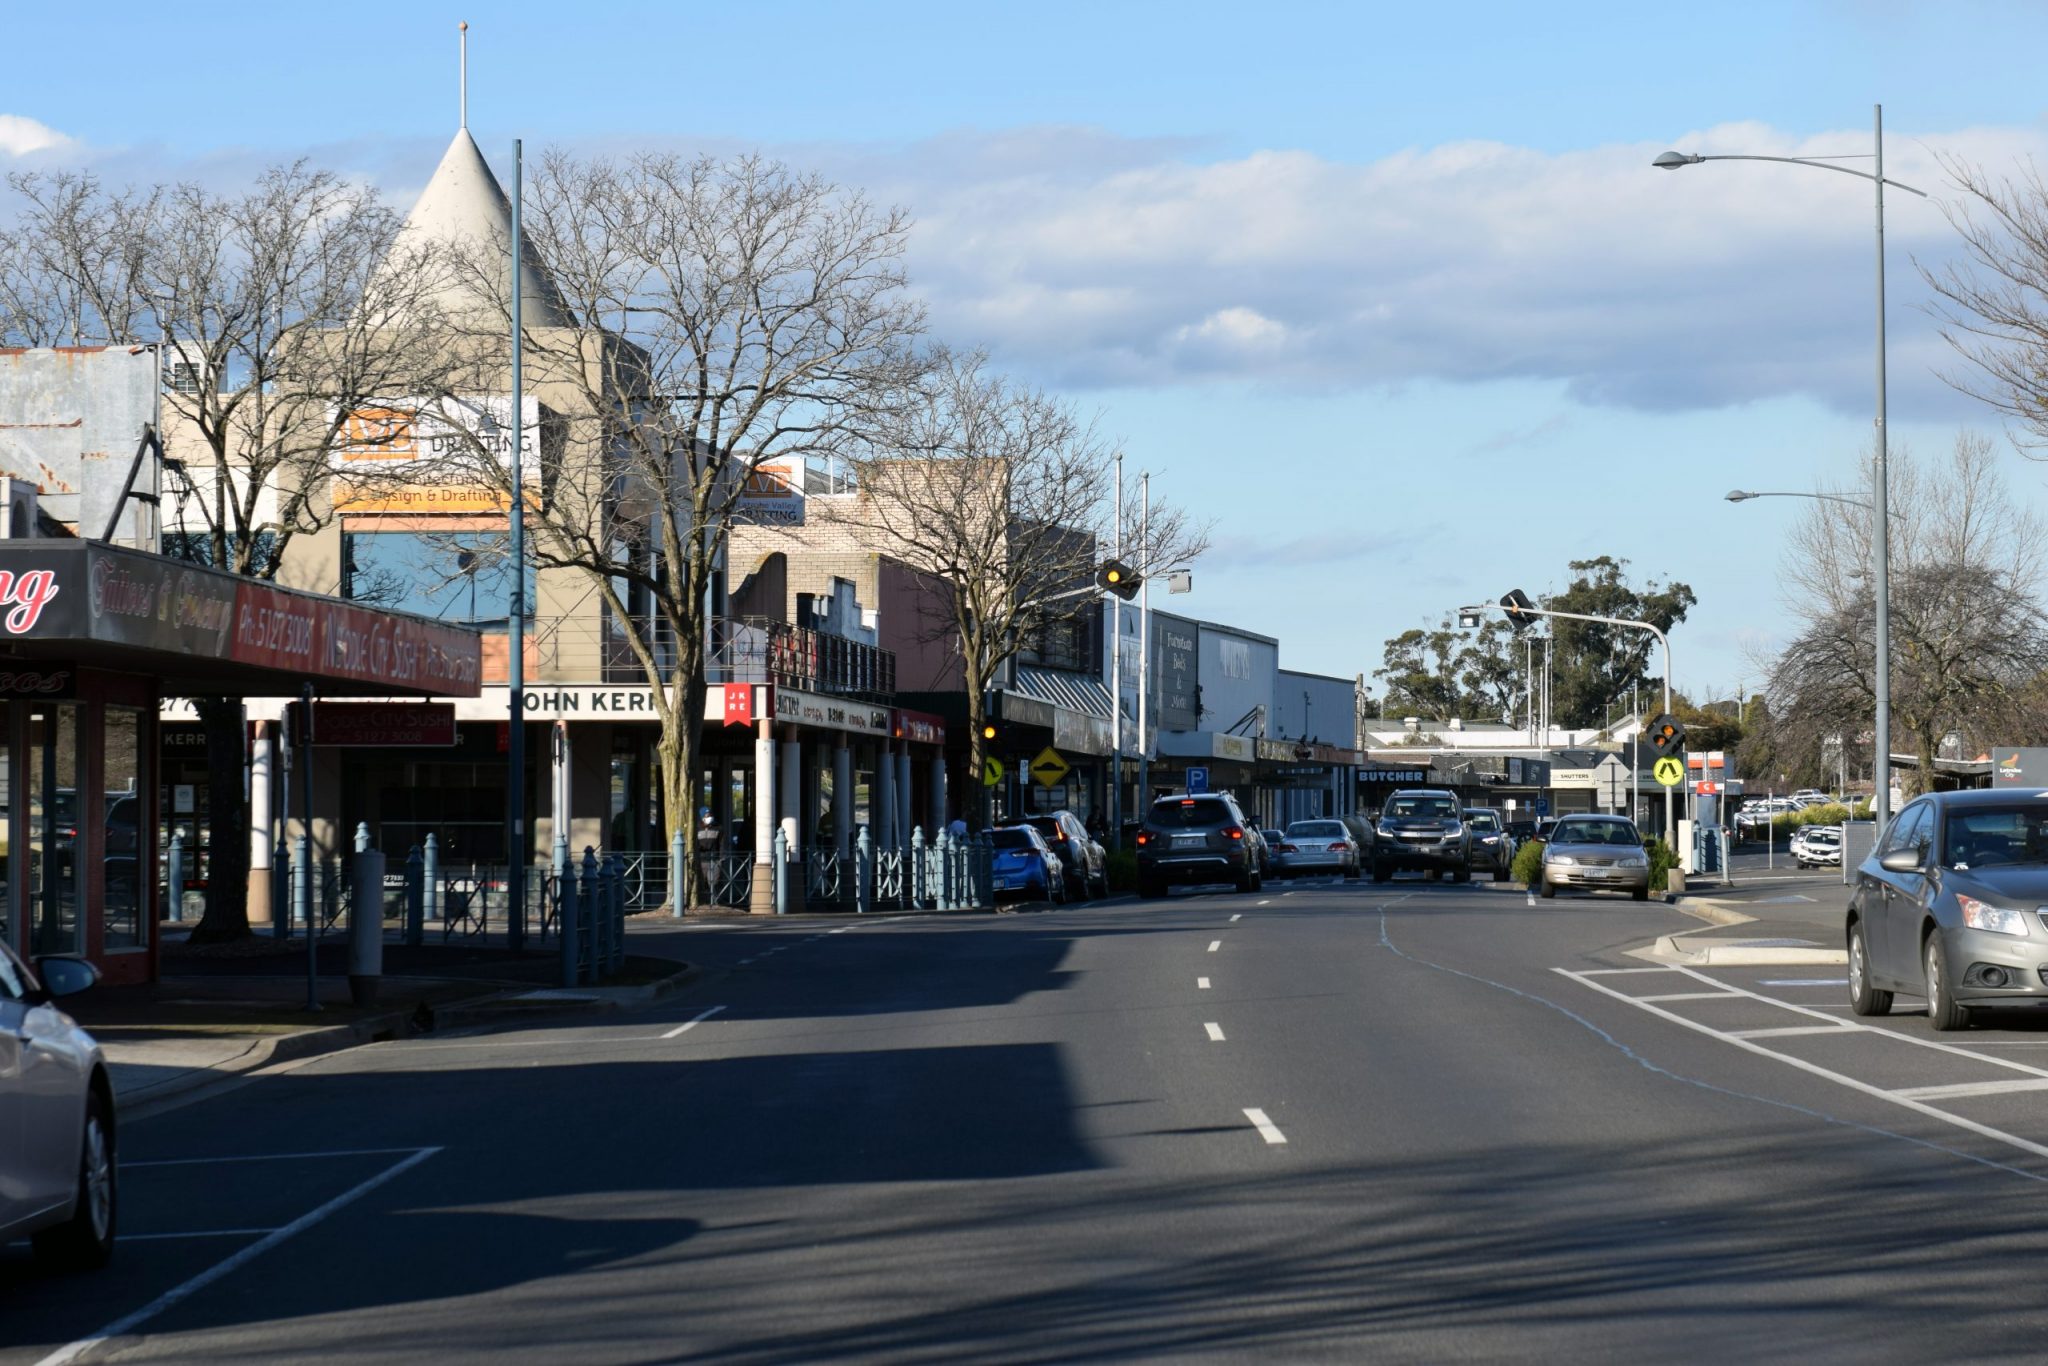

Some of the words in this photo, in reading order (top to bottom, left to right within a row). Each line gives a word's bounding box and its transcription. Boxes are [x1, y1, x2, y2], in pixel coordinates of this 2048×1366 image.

[427, 489, 436, 501] &
[772, 502, 797, 510] Valley
[592, 692, 656, 711] KER
[165, 733, 206, 745] KERR
[1191, 771, 1204, 786] P
[1359, 771, 1423, 781] BUTCHER
[1538, 800, 1545, 810] P
